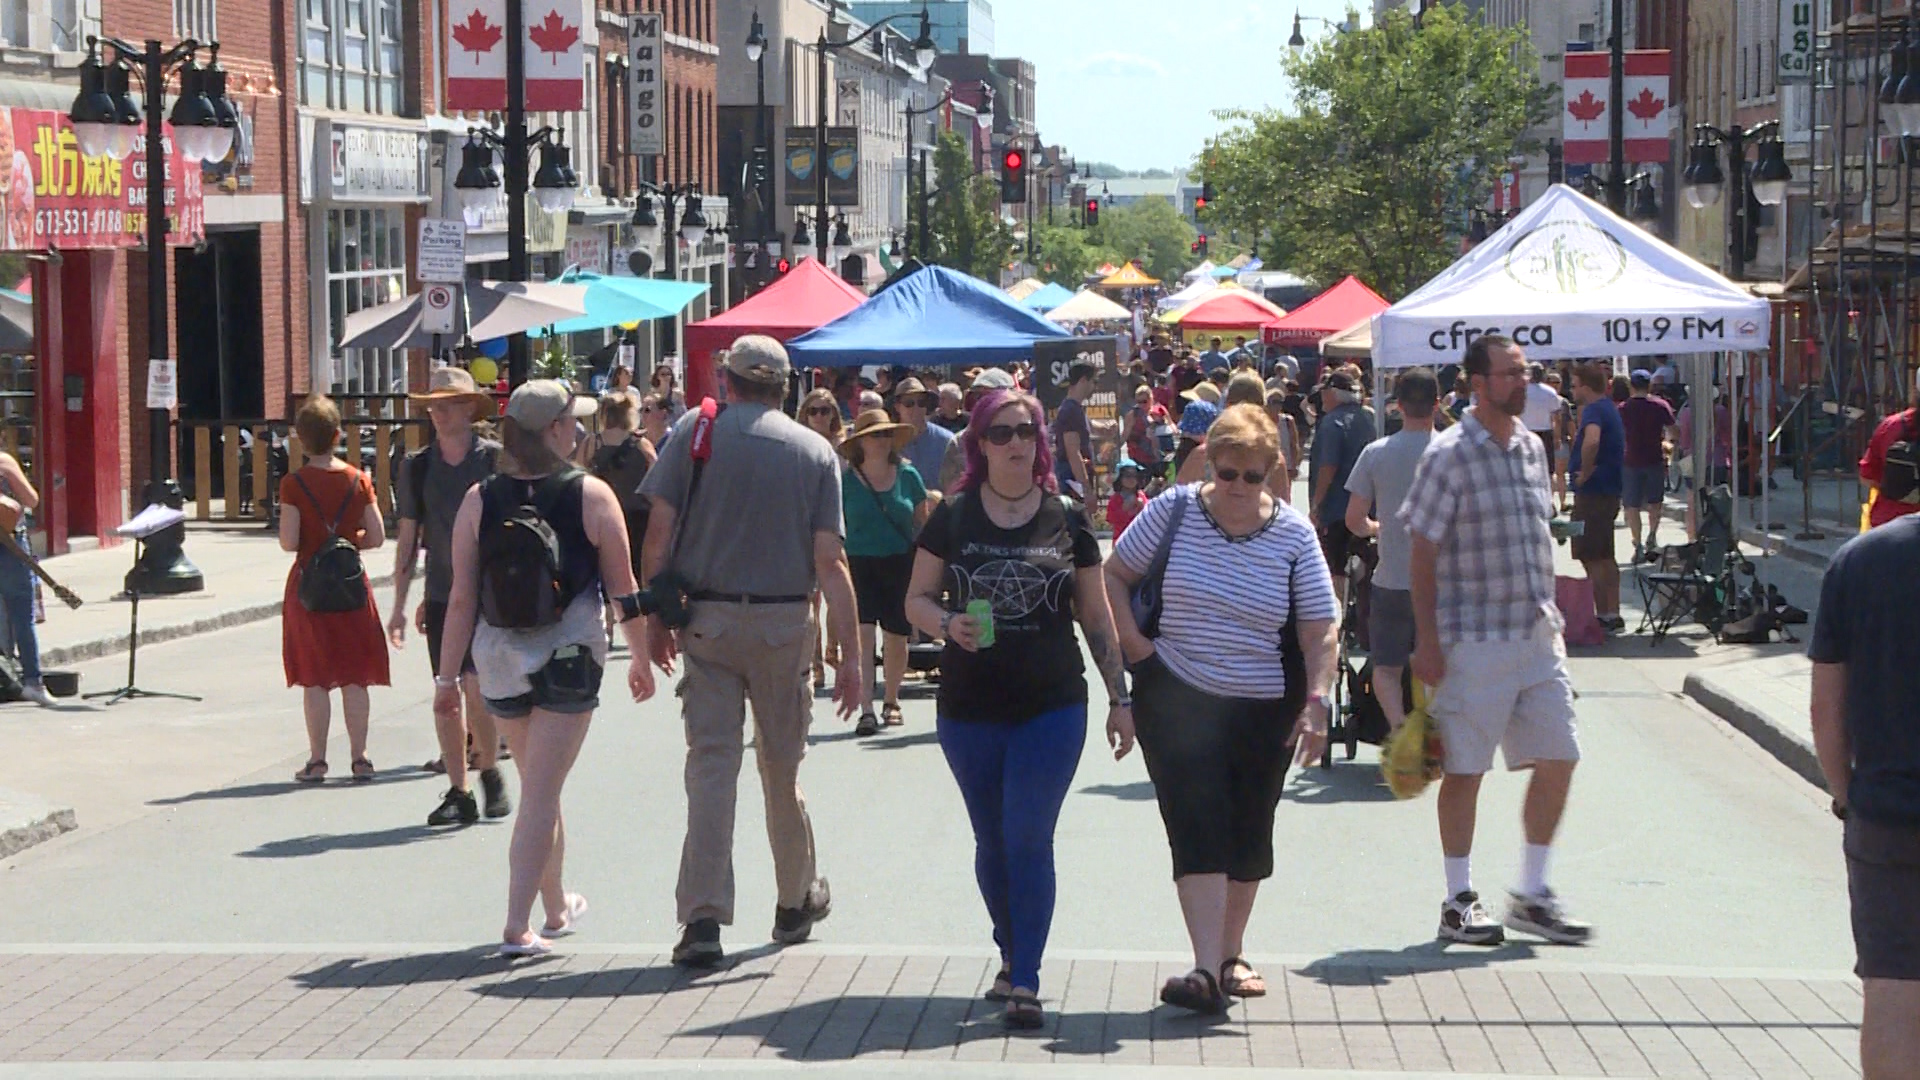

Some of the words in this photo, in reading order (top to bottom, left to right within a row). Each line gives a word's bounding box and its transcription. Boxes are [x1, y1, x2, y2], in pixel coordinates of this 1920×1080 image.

[632, 17, 658, 128] Mango
[1602, 318, 1671, 342] 101.9
[1682, 317, 1724, 340] FM
